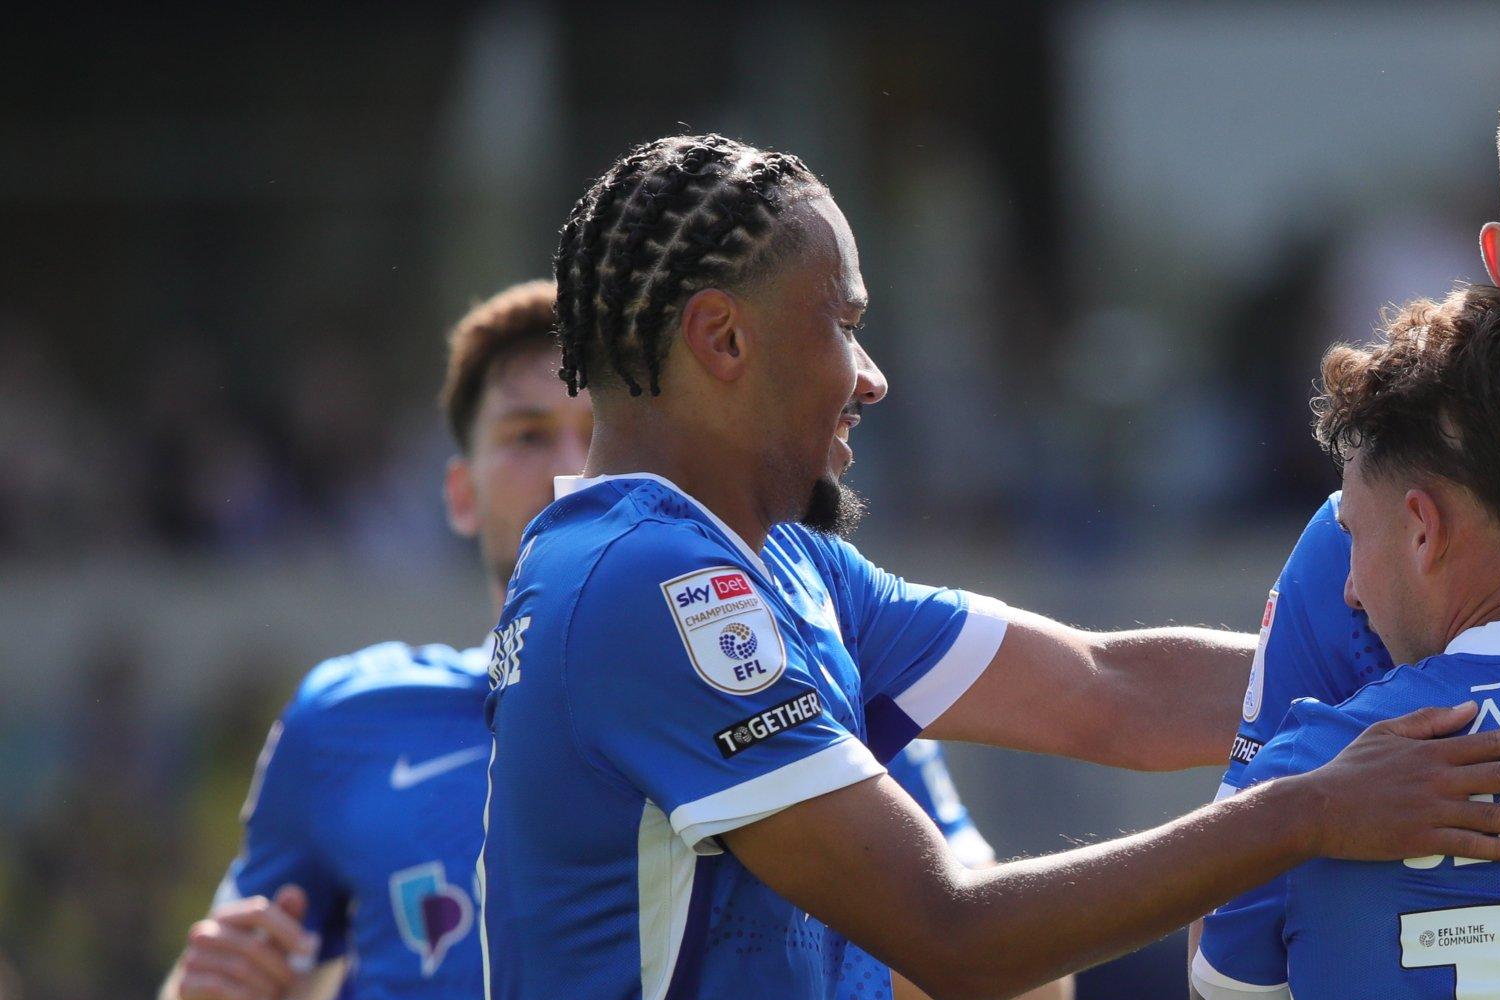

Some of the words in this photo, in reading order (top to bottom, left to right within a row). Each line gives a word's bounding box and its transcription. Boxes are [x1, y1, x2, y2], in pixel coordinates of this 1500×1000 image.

[676, 583, 711, 608] sky
[715, 576, 749, 595] bet
[685, 598, 760, 627] CHAMPIONSHIP
[733, 660, 767, 683] EFL
[1438, 928, 1453, 937] EFL
[1455, 926, 1466, 936] IN
[1468, 924, 1485, 934] THE
[1438, 933, 1495, 947] COMMUNITY
